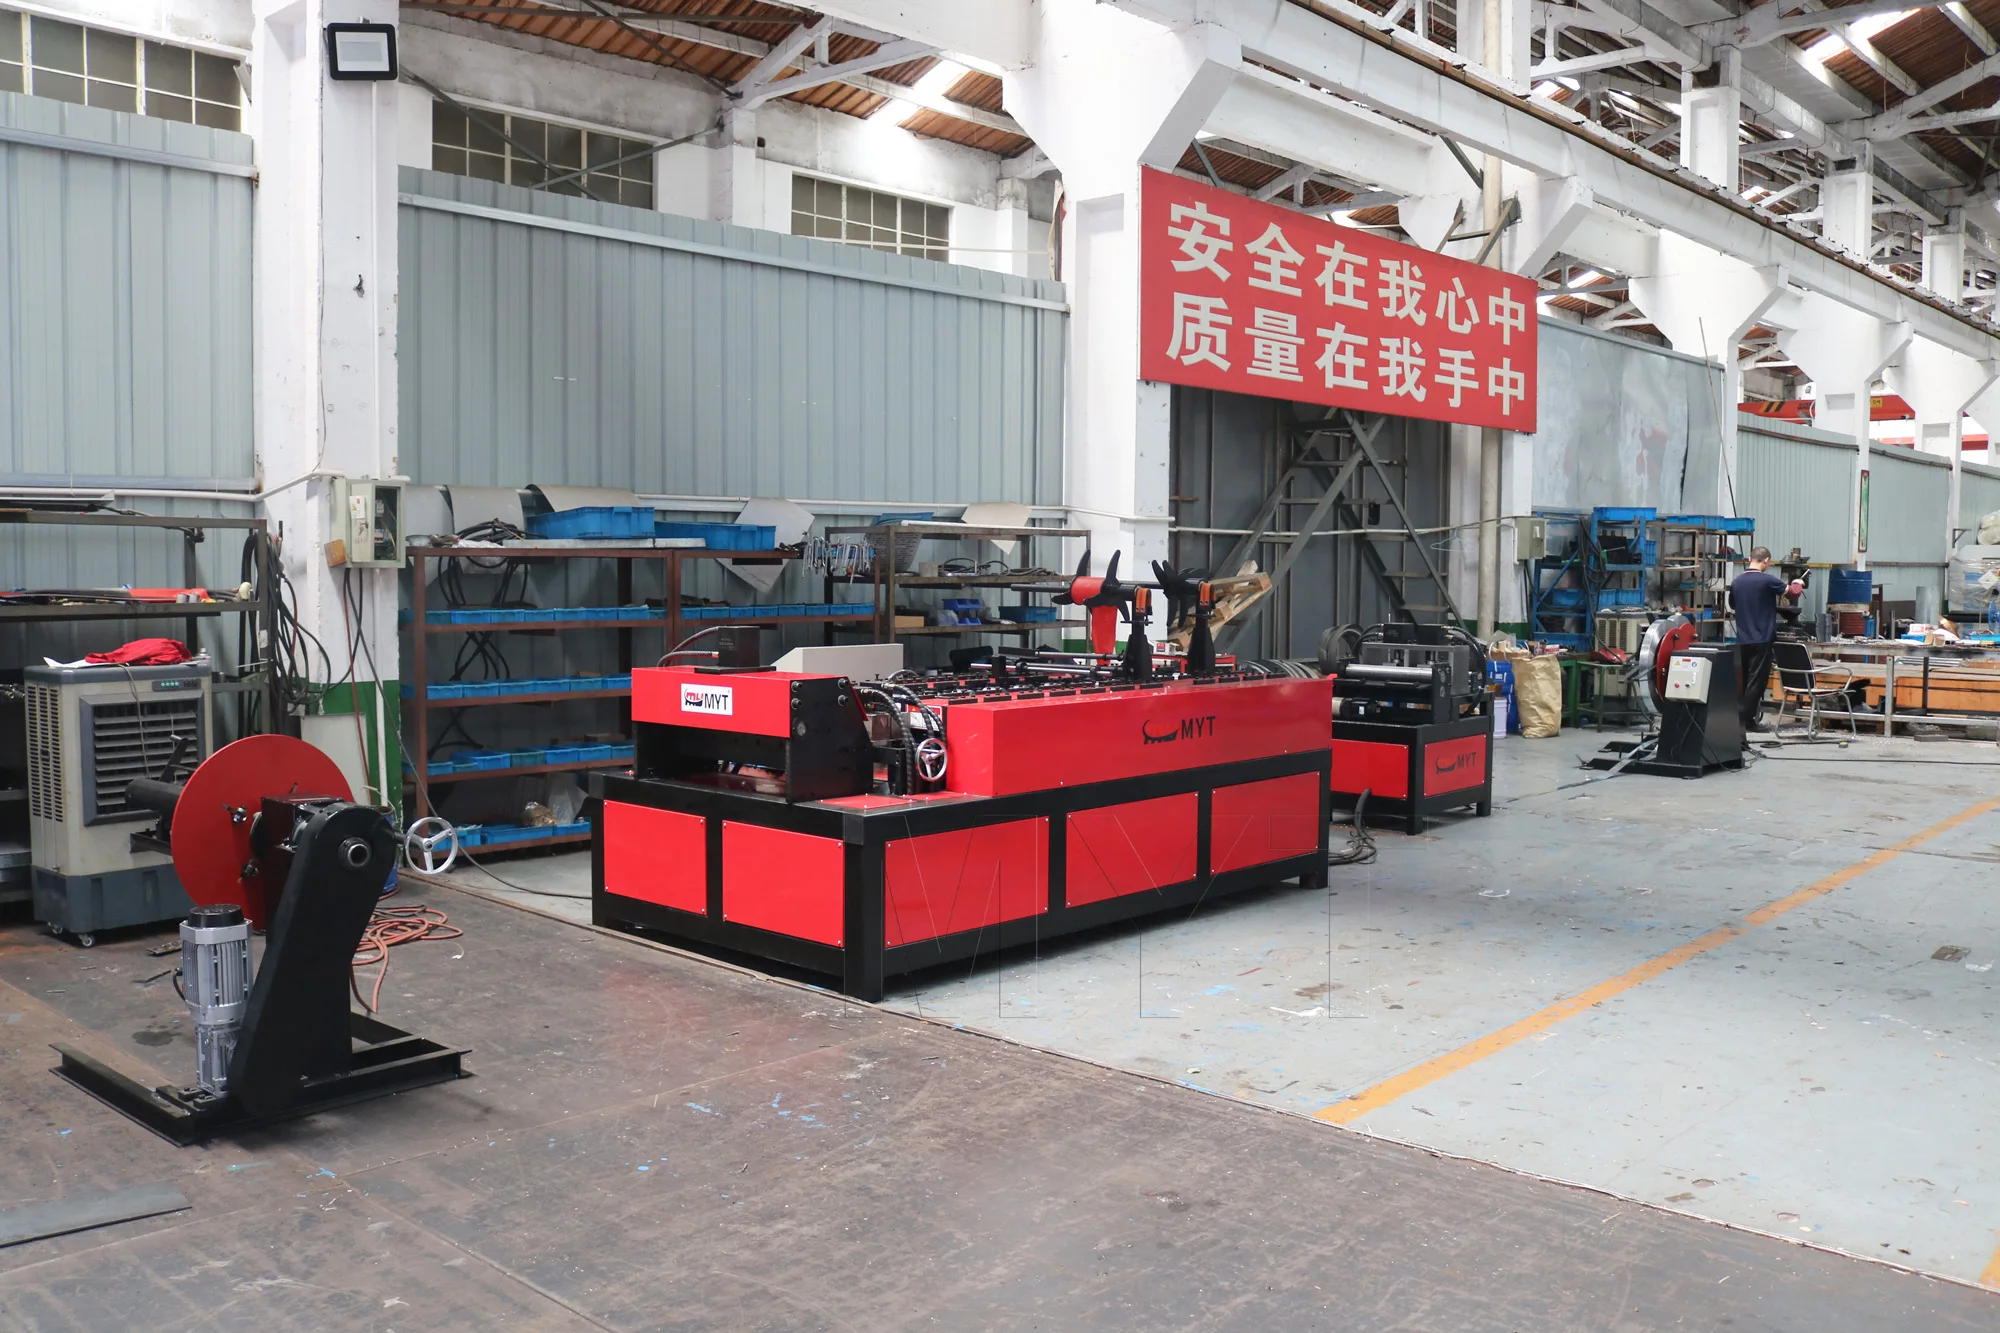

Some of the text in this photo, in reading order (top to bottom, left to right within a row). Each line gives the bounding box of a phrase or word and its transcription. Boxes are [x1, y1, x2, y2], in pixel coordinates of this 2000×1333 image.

[1167, 201, 1526, 347] 安全在我心中
[1166, 292, 1526, 417] 质量在我手中
[704, 693, 729, 710] MYT
[1181, 715, 1217, 740] MYT
[1457, 751, 1477, 769] MYT
